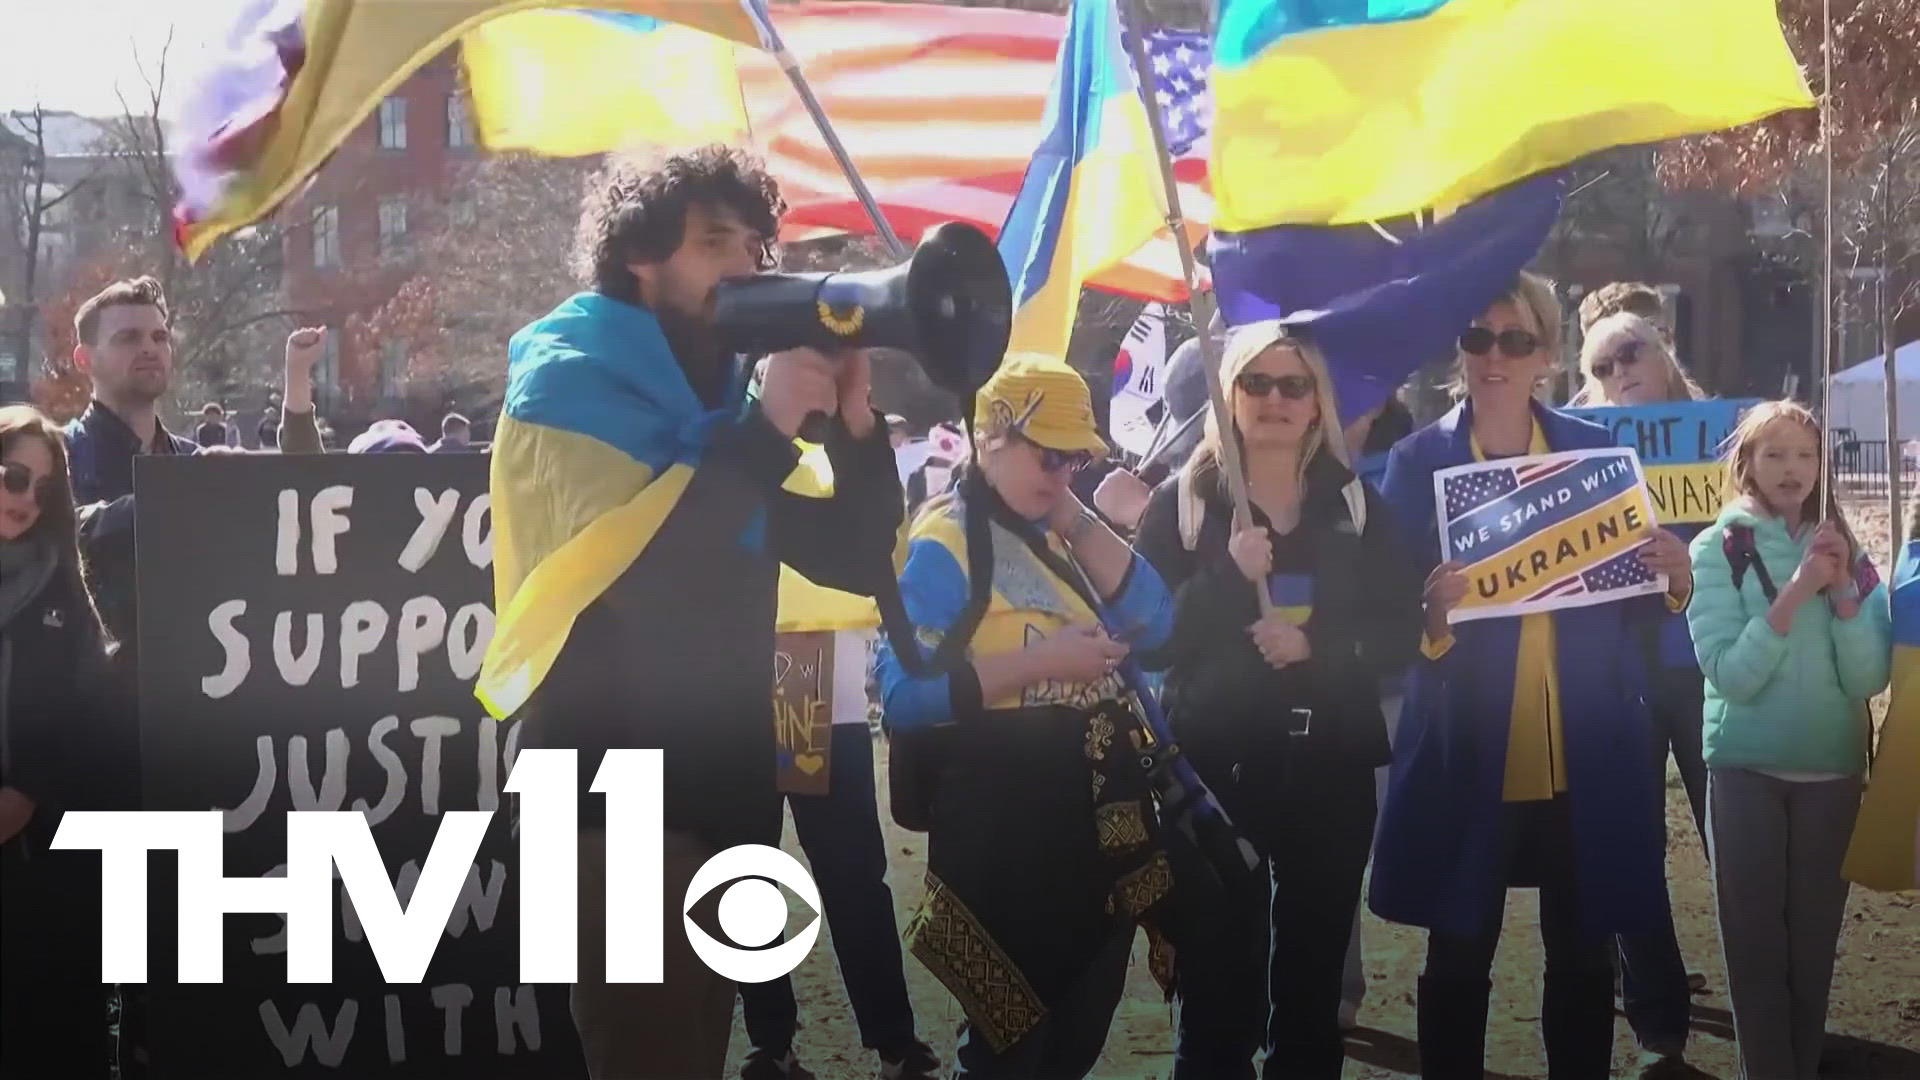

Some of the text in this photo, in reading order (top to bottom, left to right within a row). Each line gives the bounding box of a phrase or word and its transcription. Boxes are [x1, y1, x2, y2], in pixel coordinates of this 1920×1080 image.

[276, 485, 354, 575] IF
[1455, 457, 1628, 552] WE STAND WITH
[1477, 505, 1643, 599] UKRAINE
[202, 595, 497, 699] SUPPO
[258, 983, 542, 1068] WITH
